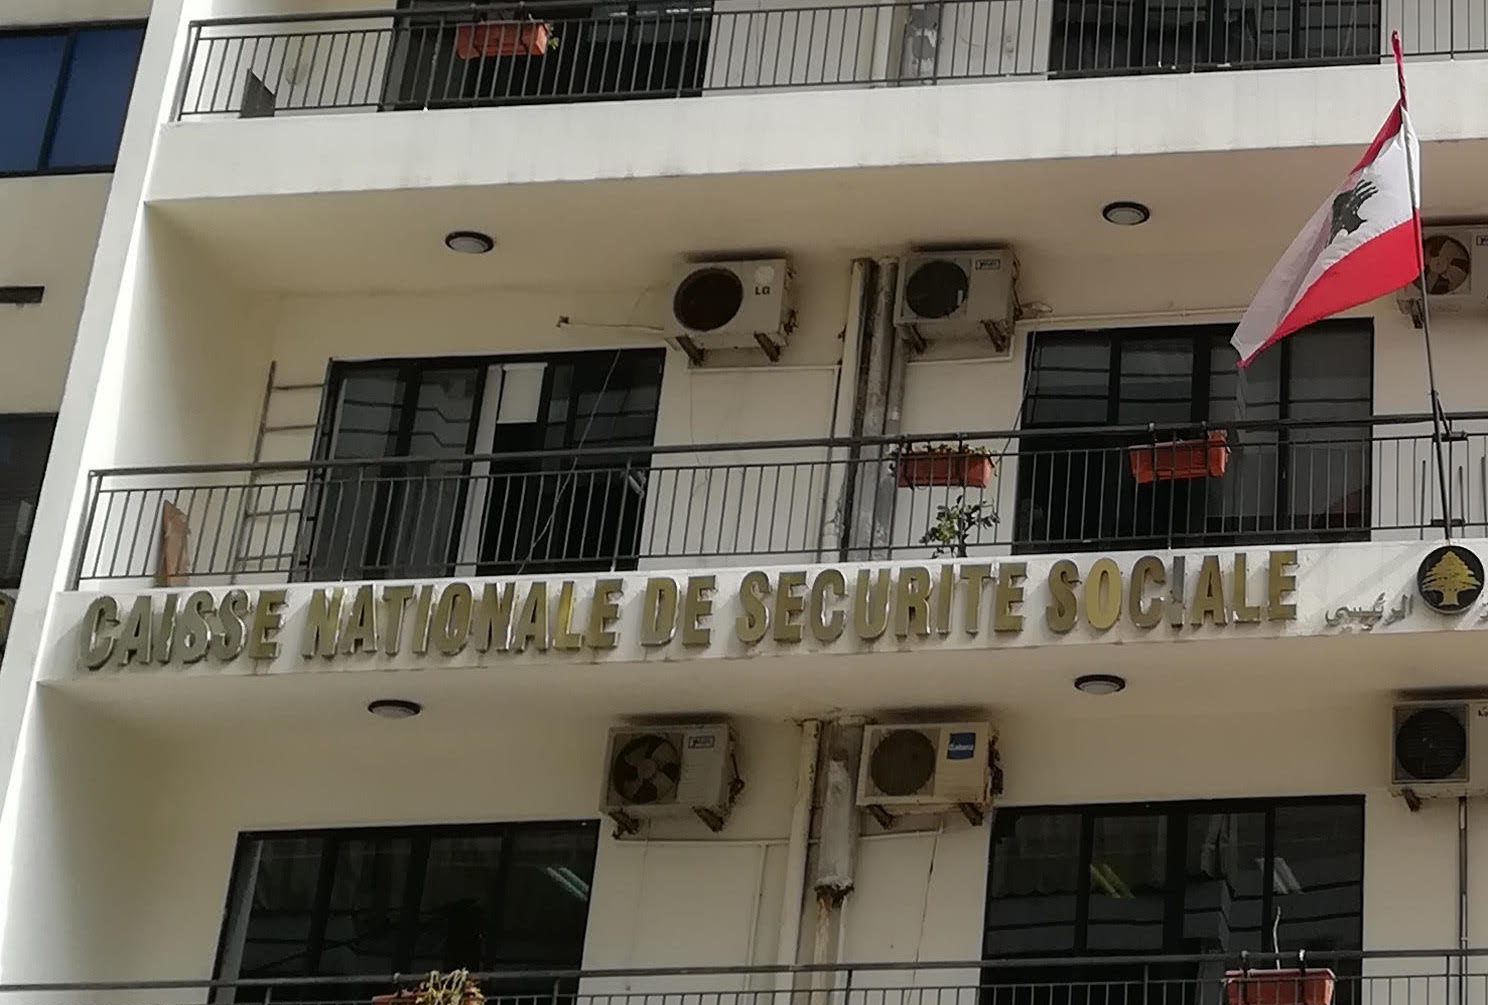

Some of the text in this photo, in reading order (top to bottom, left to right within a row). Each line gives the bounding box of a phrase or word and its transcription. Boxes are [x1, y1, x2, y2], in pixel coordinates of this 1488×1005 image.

[755, 286, 771, 296] LG
[82, 550, 1299, 670] CAISSE NATIONALE DE SECURITE SOCIALE
